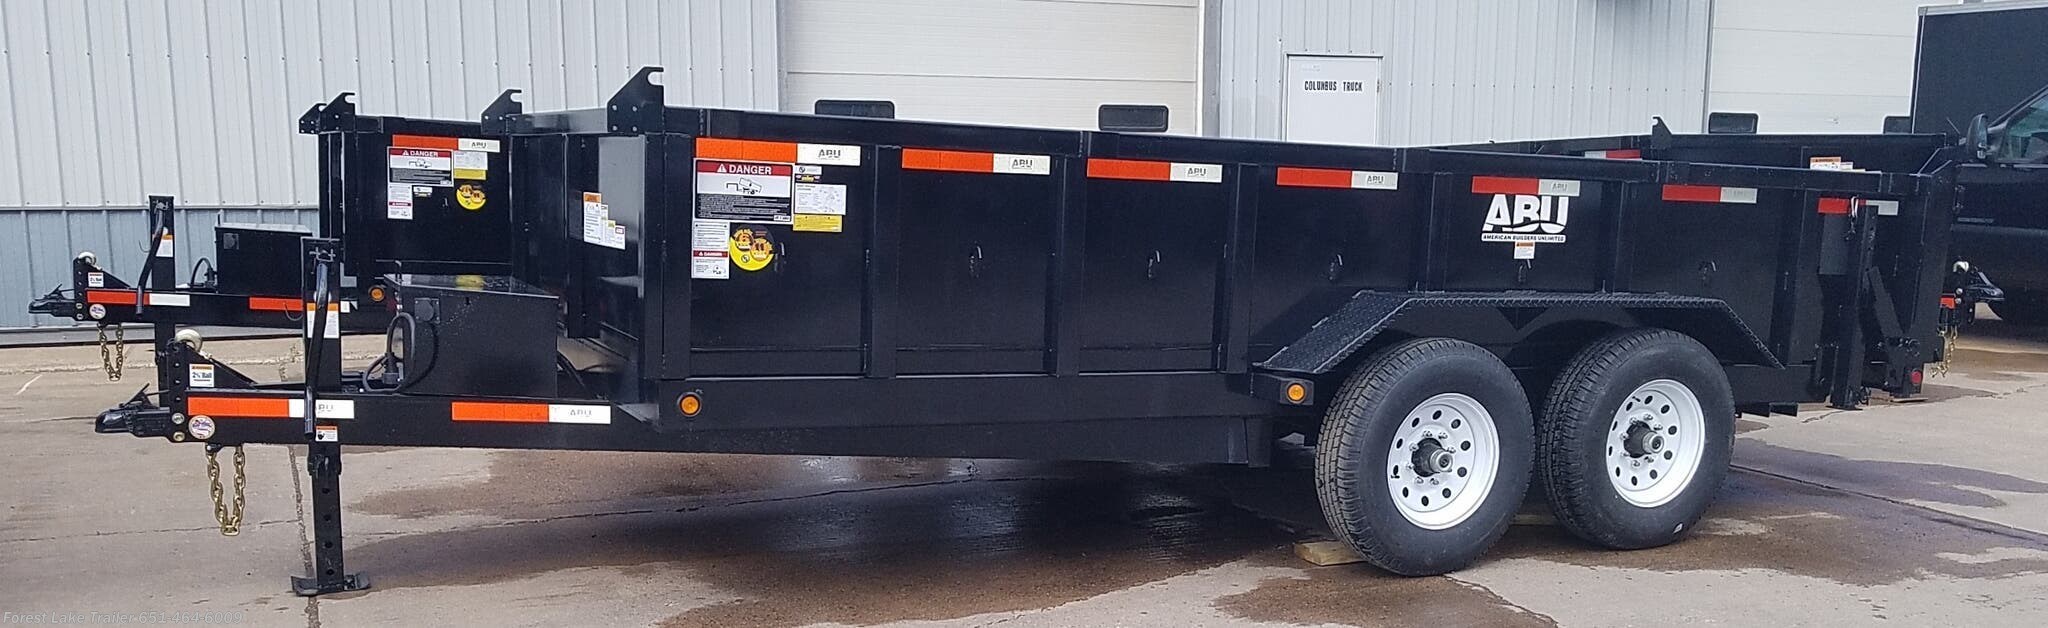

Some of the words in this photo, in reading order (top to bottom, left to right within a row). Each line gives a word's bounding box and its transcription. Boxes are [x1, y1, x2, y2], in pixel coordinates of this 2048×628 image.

[1304, 81, 1337, 91] COLUMBUS
[1343, 82, 1363, 92] TRUCK
[817, 149, 842, 159] ABU
[729, 164, 772, 175] DANGER
[1012, 159, 1033, 169] ABU
[1481, 193, 1569, 234] ABU
